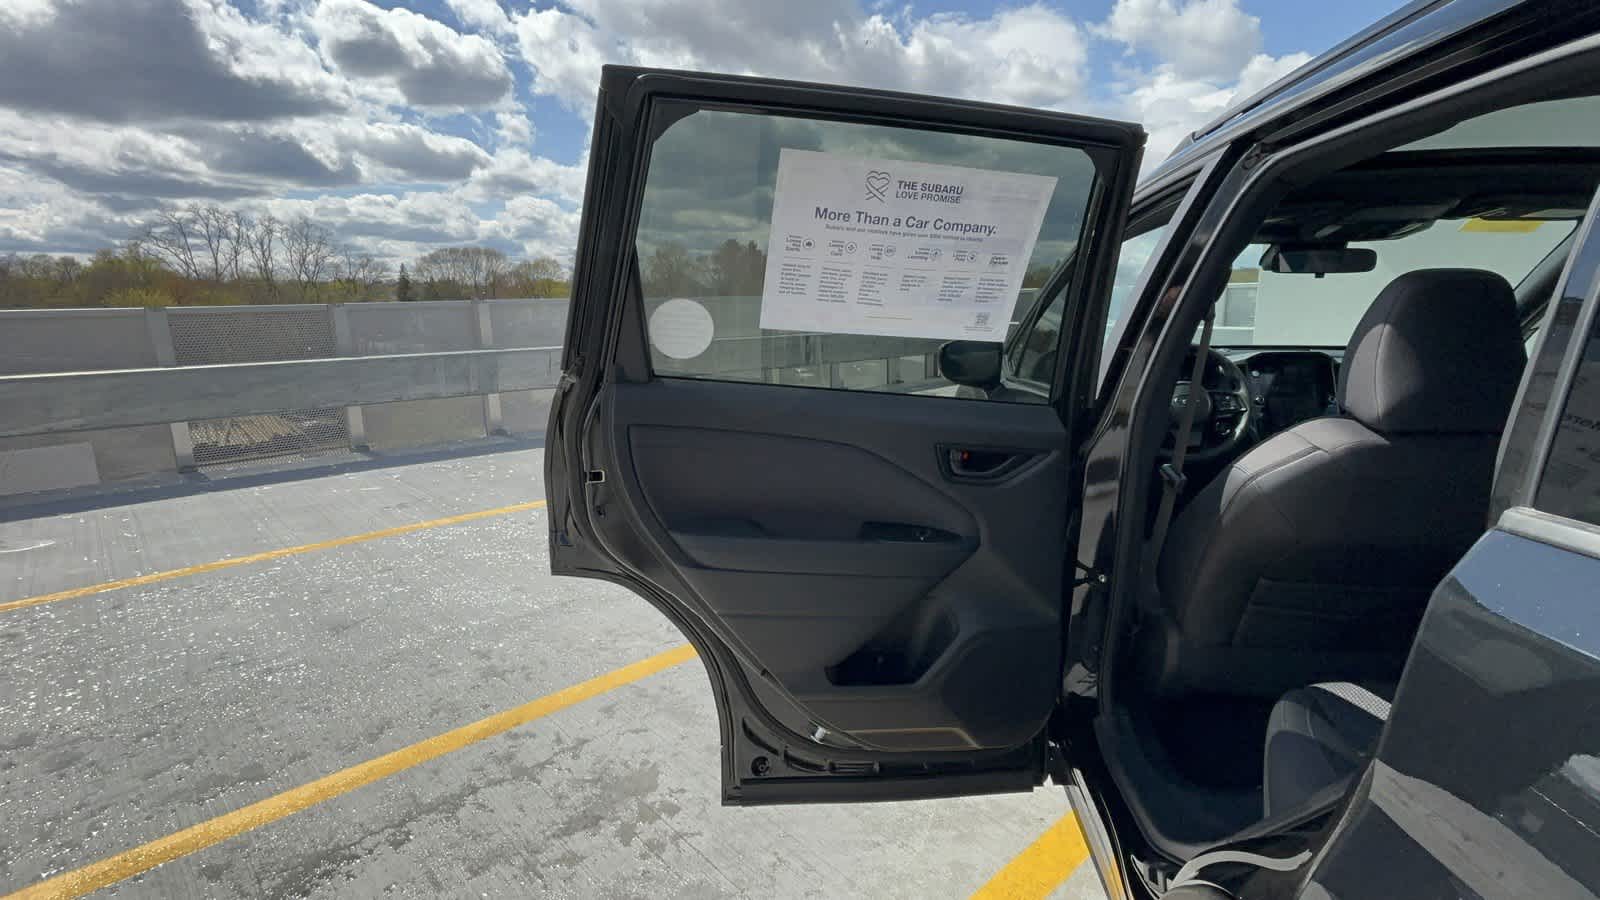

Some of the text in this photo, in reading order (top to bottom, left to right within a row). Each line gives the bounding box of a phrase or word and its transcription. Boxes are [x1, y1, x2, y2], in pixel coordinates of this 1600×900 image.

[897, 180, 964, 195] THE SUBARU
[895, 190, 961, 204] LOVE PROMISE
[814, 206, 997, 235] More Than a Car Company.
